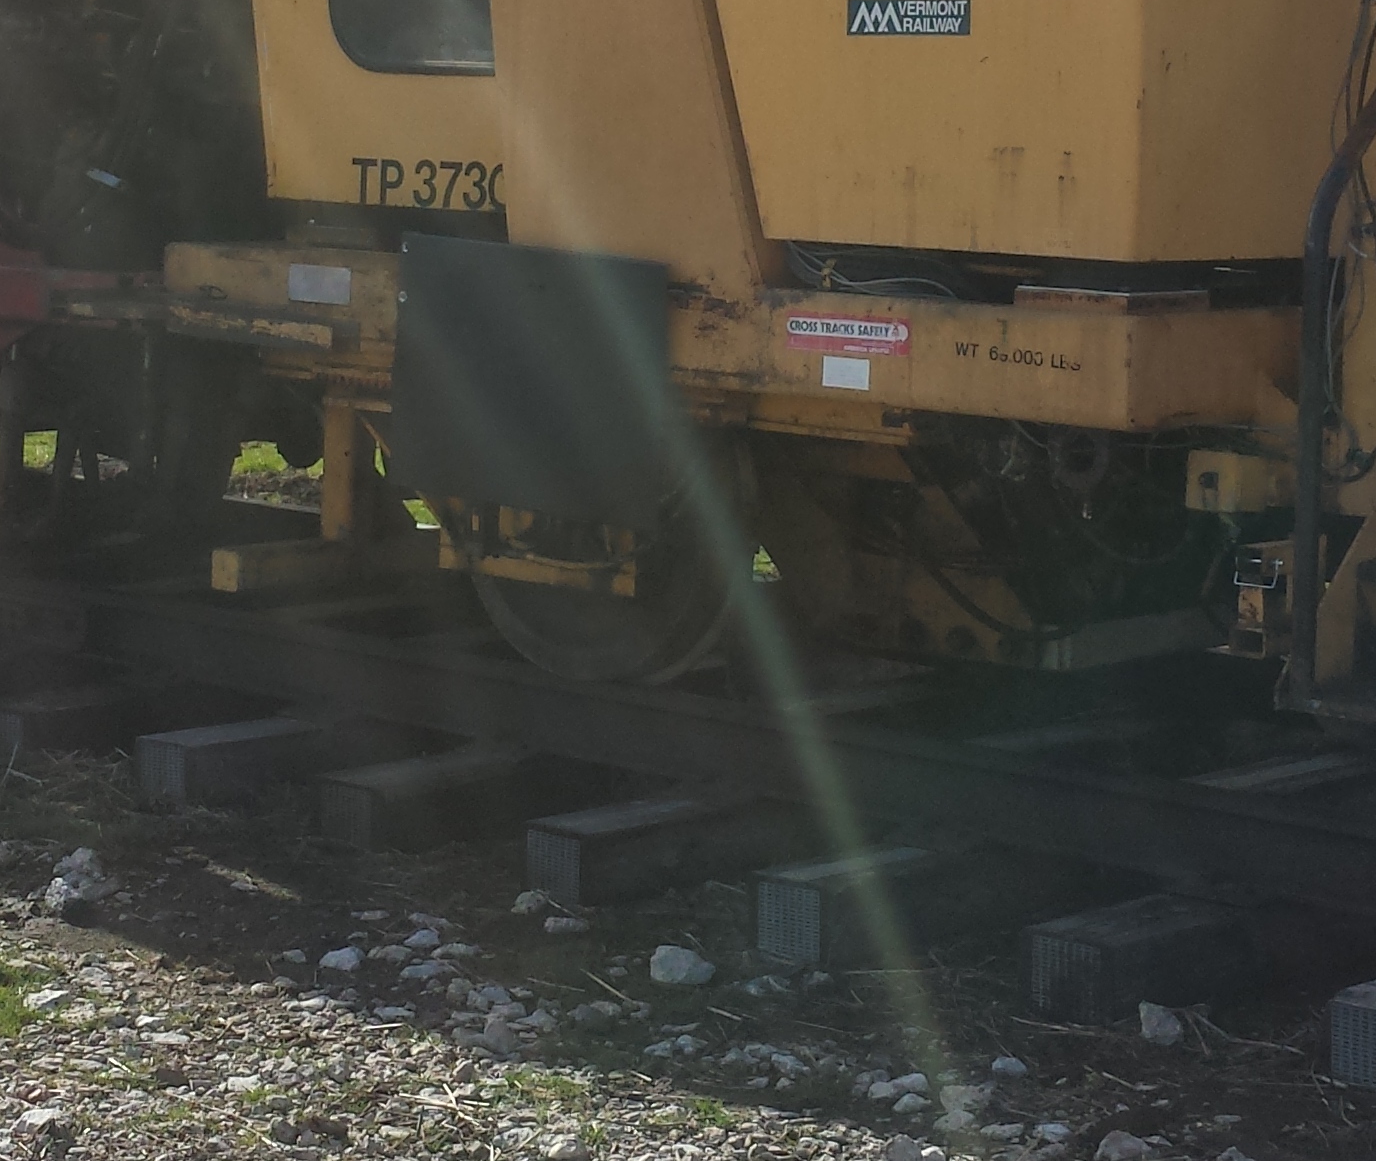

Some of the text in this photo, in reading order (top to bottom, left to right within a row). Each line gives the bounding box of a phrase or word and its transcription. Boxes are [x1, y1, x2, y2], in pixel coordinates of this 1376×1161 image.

[898, 0, 967, 16] VERMONT
[903, 17, 963, 33] RAILWAY
[352, 157, 405, 205] TP
[789, 319, 819, 333] CROSS
[820, 321, 855, 336] TRACKS
[955, 341, 979, 358] WT
